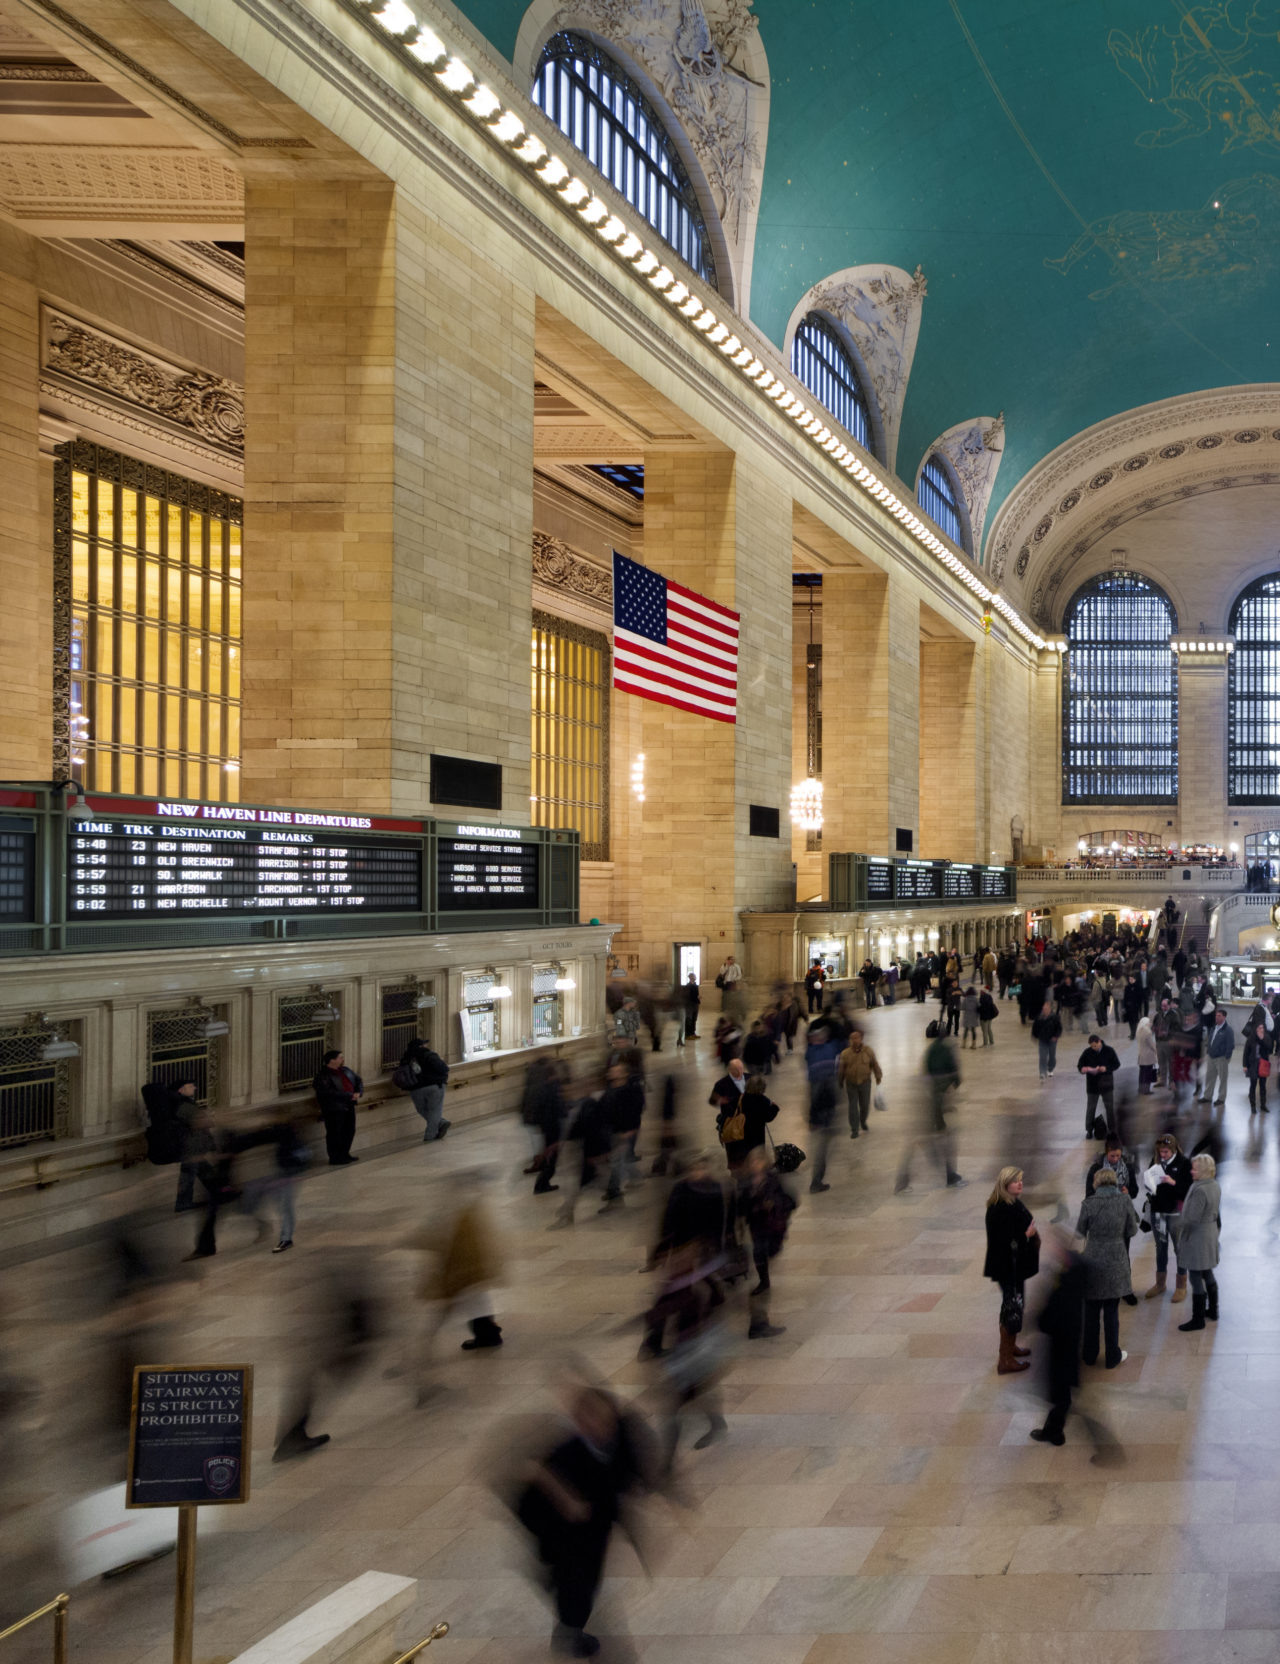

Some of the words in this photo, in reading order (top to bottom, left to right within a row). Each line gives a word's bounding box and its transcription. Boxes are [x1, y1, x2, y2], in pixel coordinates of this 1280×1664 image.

[157, 803, 199, 817] NEW
[203, 806, 256, 821] HAVEN
[259, 810, 292, 823] LINE
[294, 813, 372, 828] DEPARTURES
[76, 822, 113, 833] TIME
[124, 824, 154, 835] TRK
[161, 826, 246, 840] DESTINATION
[262, 832, 314, 842] REMARKS
[457, 825, 521, 839] INFORMATION
[76, 838, 107, 849] 5:48
[132, 841, 146, 850] 23
[157, 842, 177, 852] NEW
[181, 843, 212, 853] HAVEN
[258, 846, 299, 856] STAMFORD
[312, 847, 326, 857] 1ST
[329, 848, 348, 857] STOP
[76, 854, 107, 865] 5:54
[133, 855, 146, 865] 18
[157, 856, 177, 866] OLD
[181, 857, 234, 867] GREENWICH
[258, 859, 299, 869] HARRISON
[312, 860, 326, 869] 1ST
[329, 860, 348, 869] STOP
[76, 869, 107, 880] 5:57
[181, 871, 223, 881] NORWALK
[258, 872, 299, 881] STAMFORD
[312, 872, 326, 881] 1ST
[329, 873, 348, 882] STOP
[76, 885, 106, 895] 5:59
[132, 885, 145, 895] 21
[258, 885, 303, 894] LARCHMONT
[317, 885, 330, 893] 1ST
[333, 884, 352, 893] STOP
[76, 900, 106, 910] 6:02
[157, 899, 177, 908] NEW
[181, 898, 228, 908] ROCHELLE
[258, 897, 284, 907] MOUNT
[288, 897, 317, 906] VERNON
[330, 897, 343, 905] 1ST
[347, 896, 365, 905] STOP
[147, 1373, 211, 1384] SITTING
[215, 1372, 239, 1382] ON
[144, 1386, 241, 1398] STAIRWAYS
[141, 1402, 155, 1412] IS
[160, 1400, 239, 1412] STRICTLY
[207, 1458, 235, 1468] POLICE
